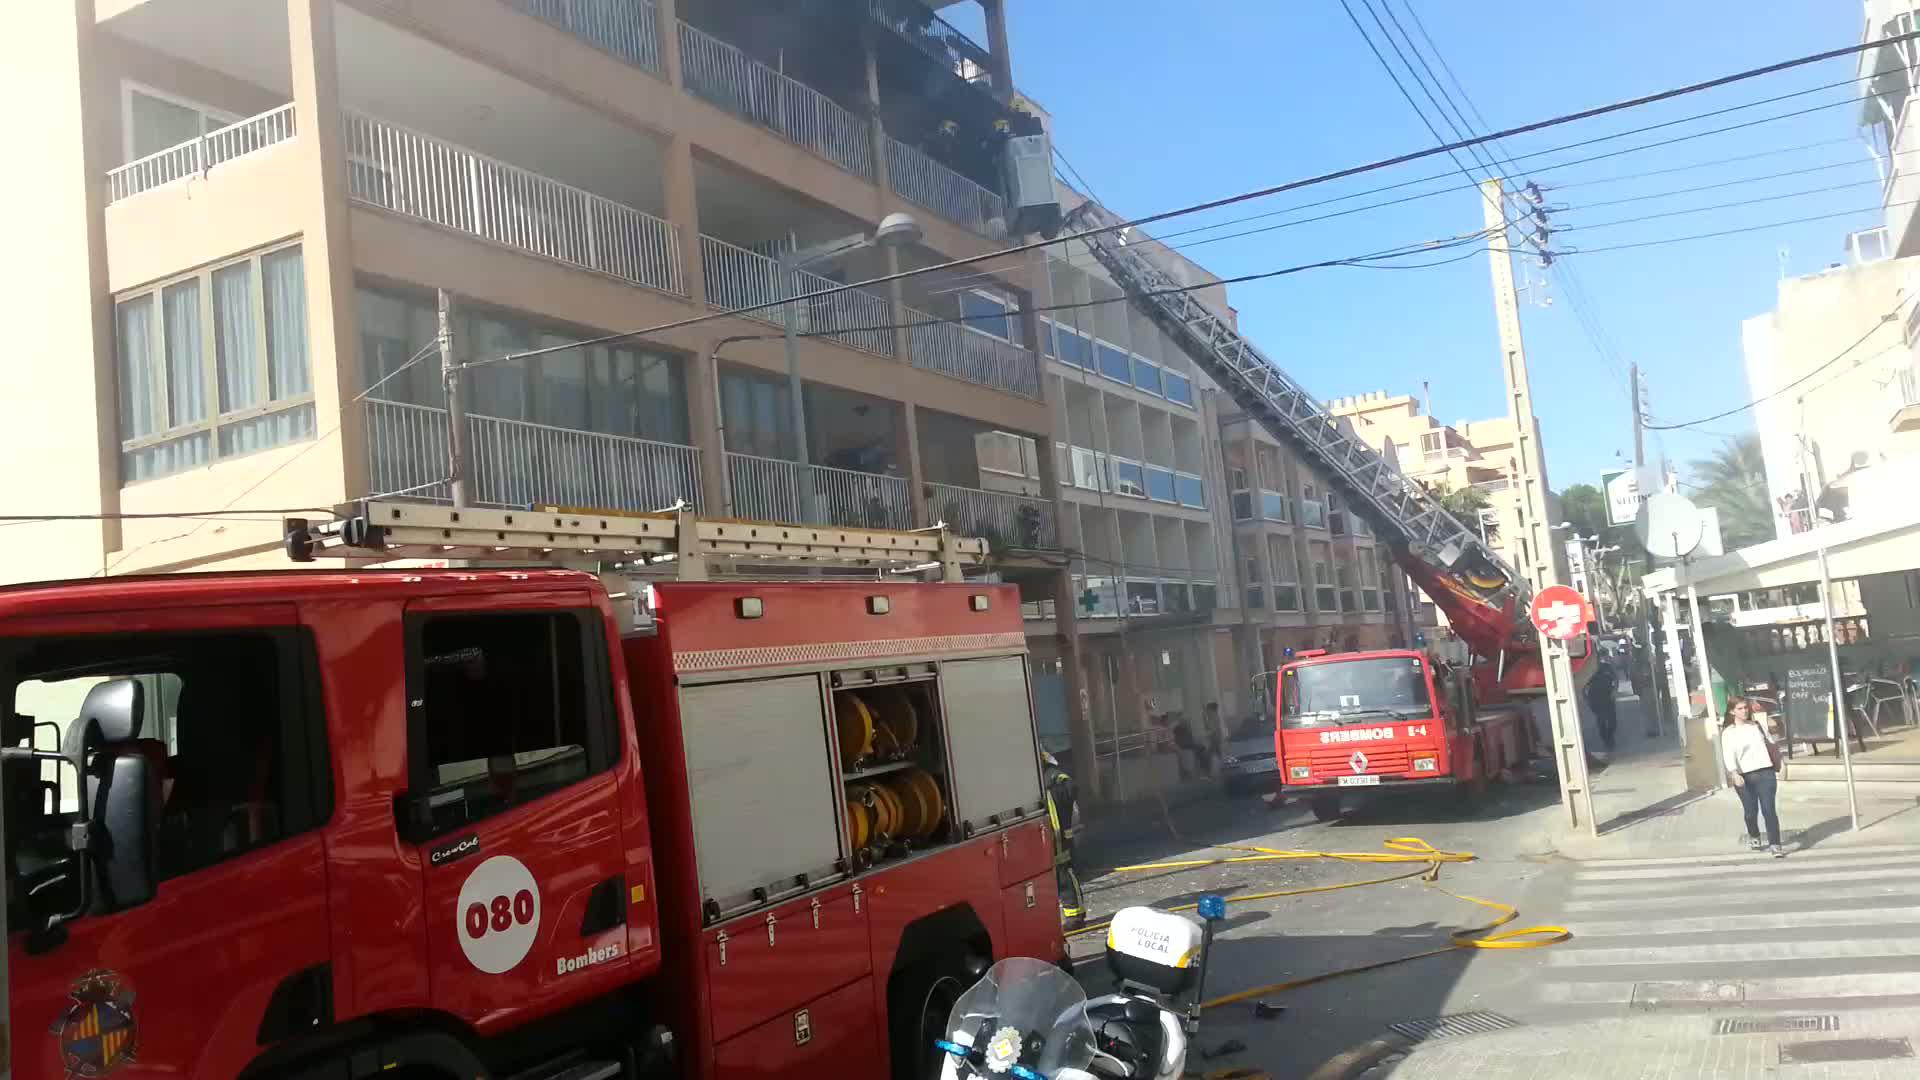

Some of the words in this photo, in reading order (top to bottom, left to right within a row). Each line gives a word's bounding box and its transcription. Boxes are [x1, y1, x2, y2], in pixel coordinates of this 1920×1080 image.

[431, 836, 479, 862] CrewCab
[465, 889, 535, 939] 080
[556, 943, 619, 975] Bombers
[1137, 938, 1169, 954] LOCAL
